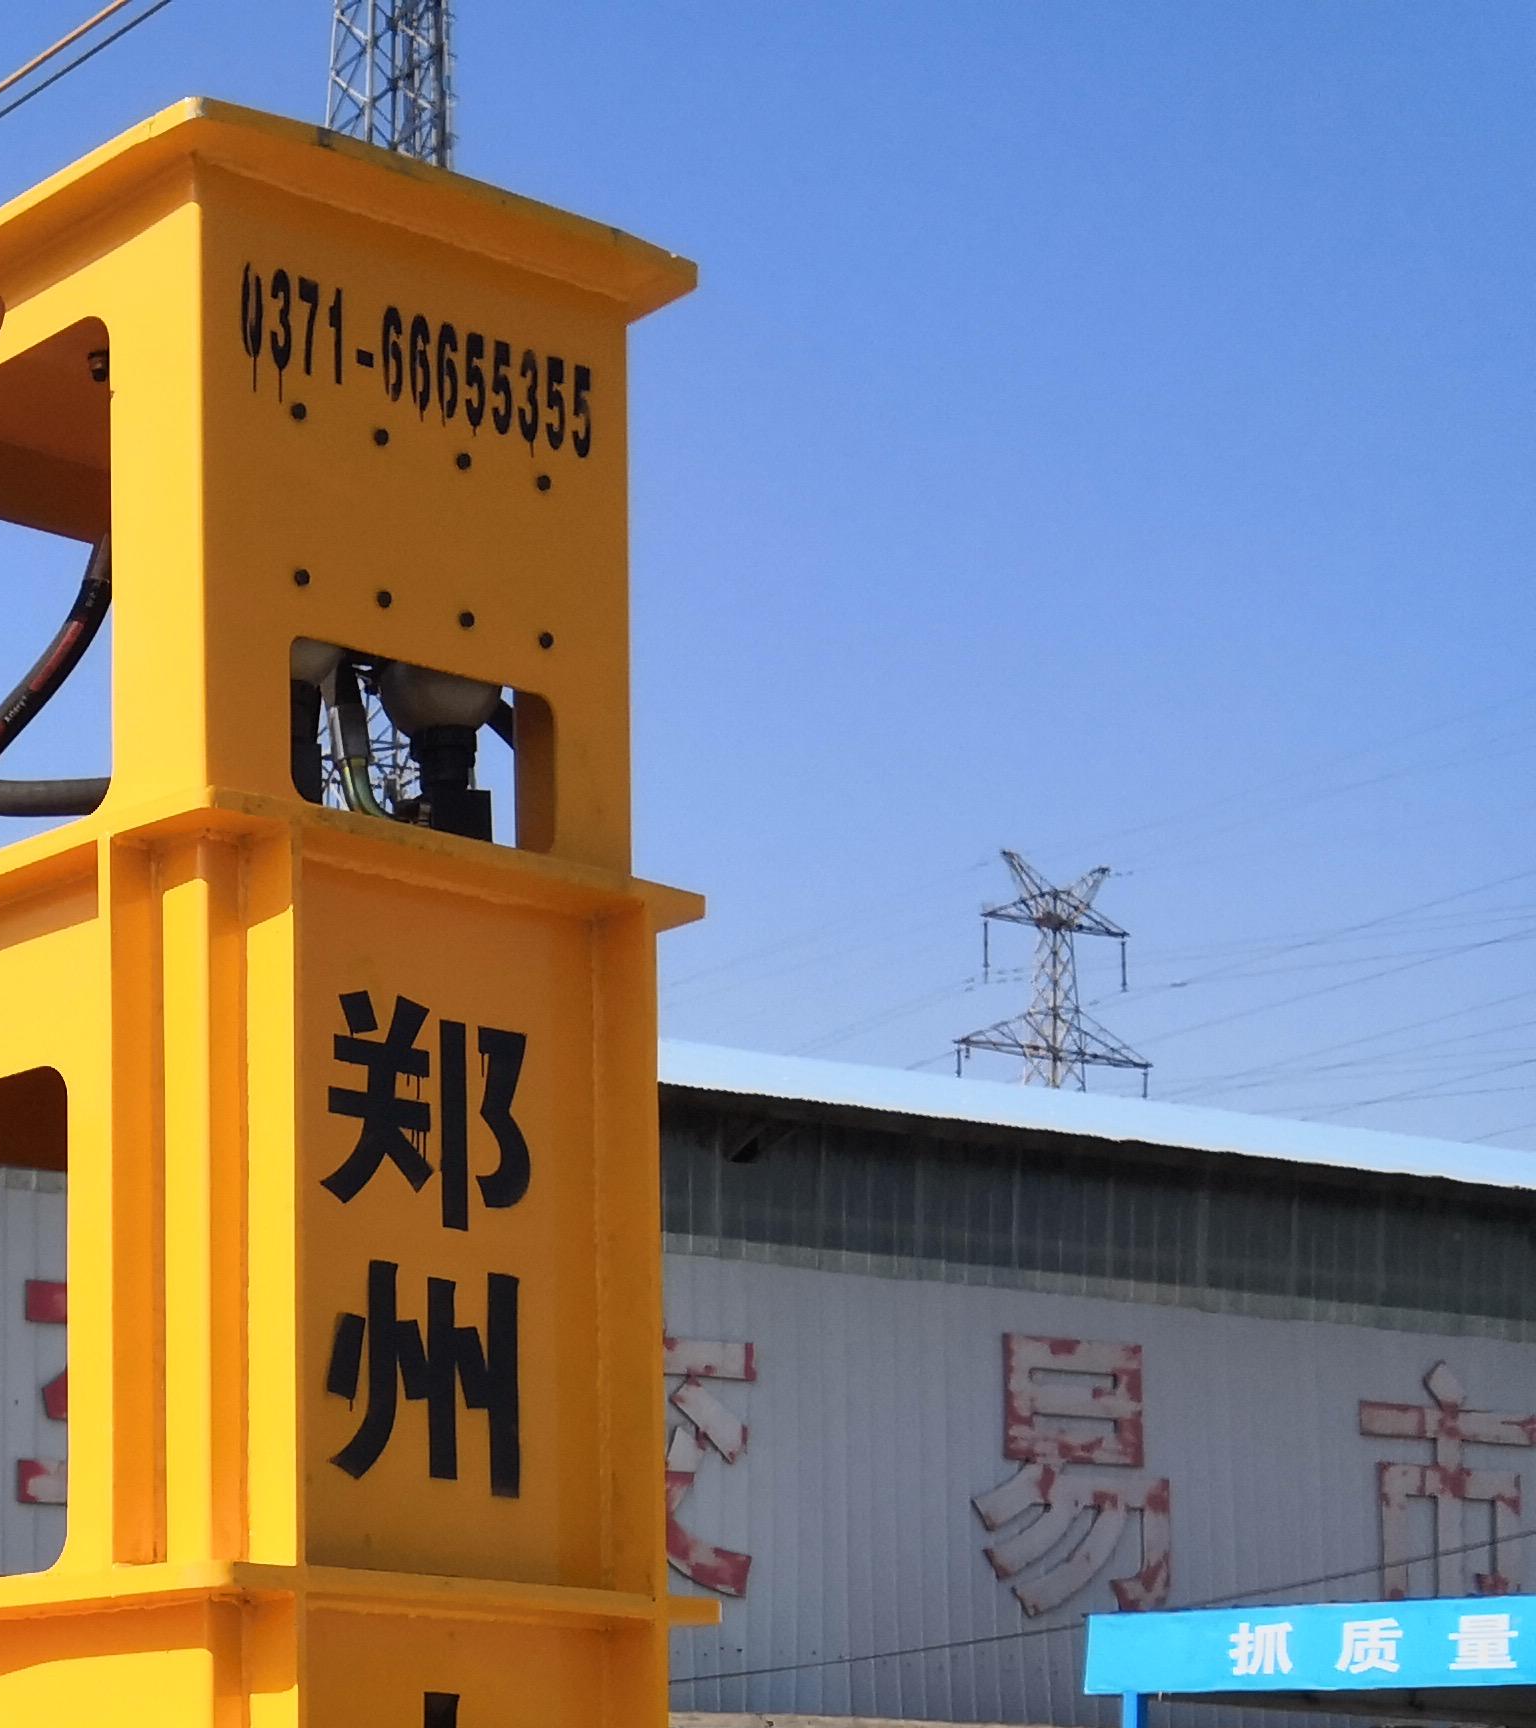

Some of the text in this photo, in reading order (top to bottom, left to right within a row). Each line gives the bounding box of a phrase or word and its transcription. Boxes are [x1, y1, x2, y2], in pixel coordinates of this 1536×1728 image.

[240, 261, 592, 459] 0371-66655355
[1228, 1613, 1519, 1676] 抓质量
